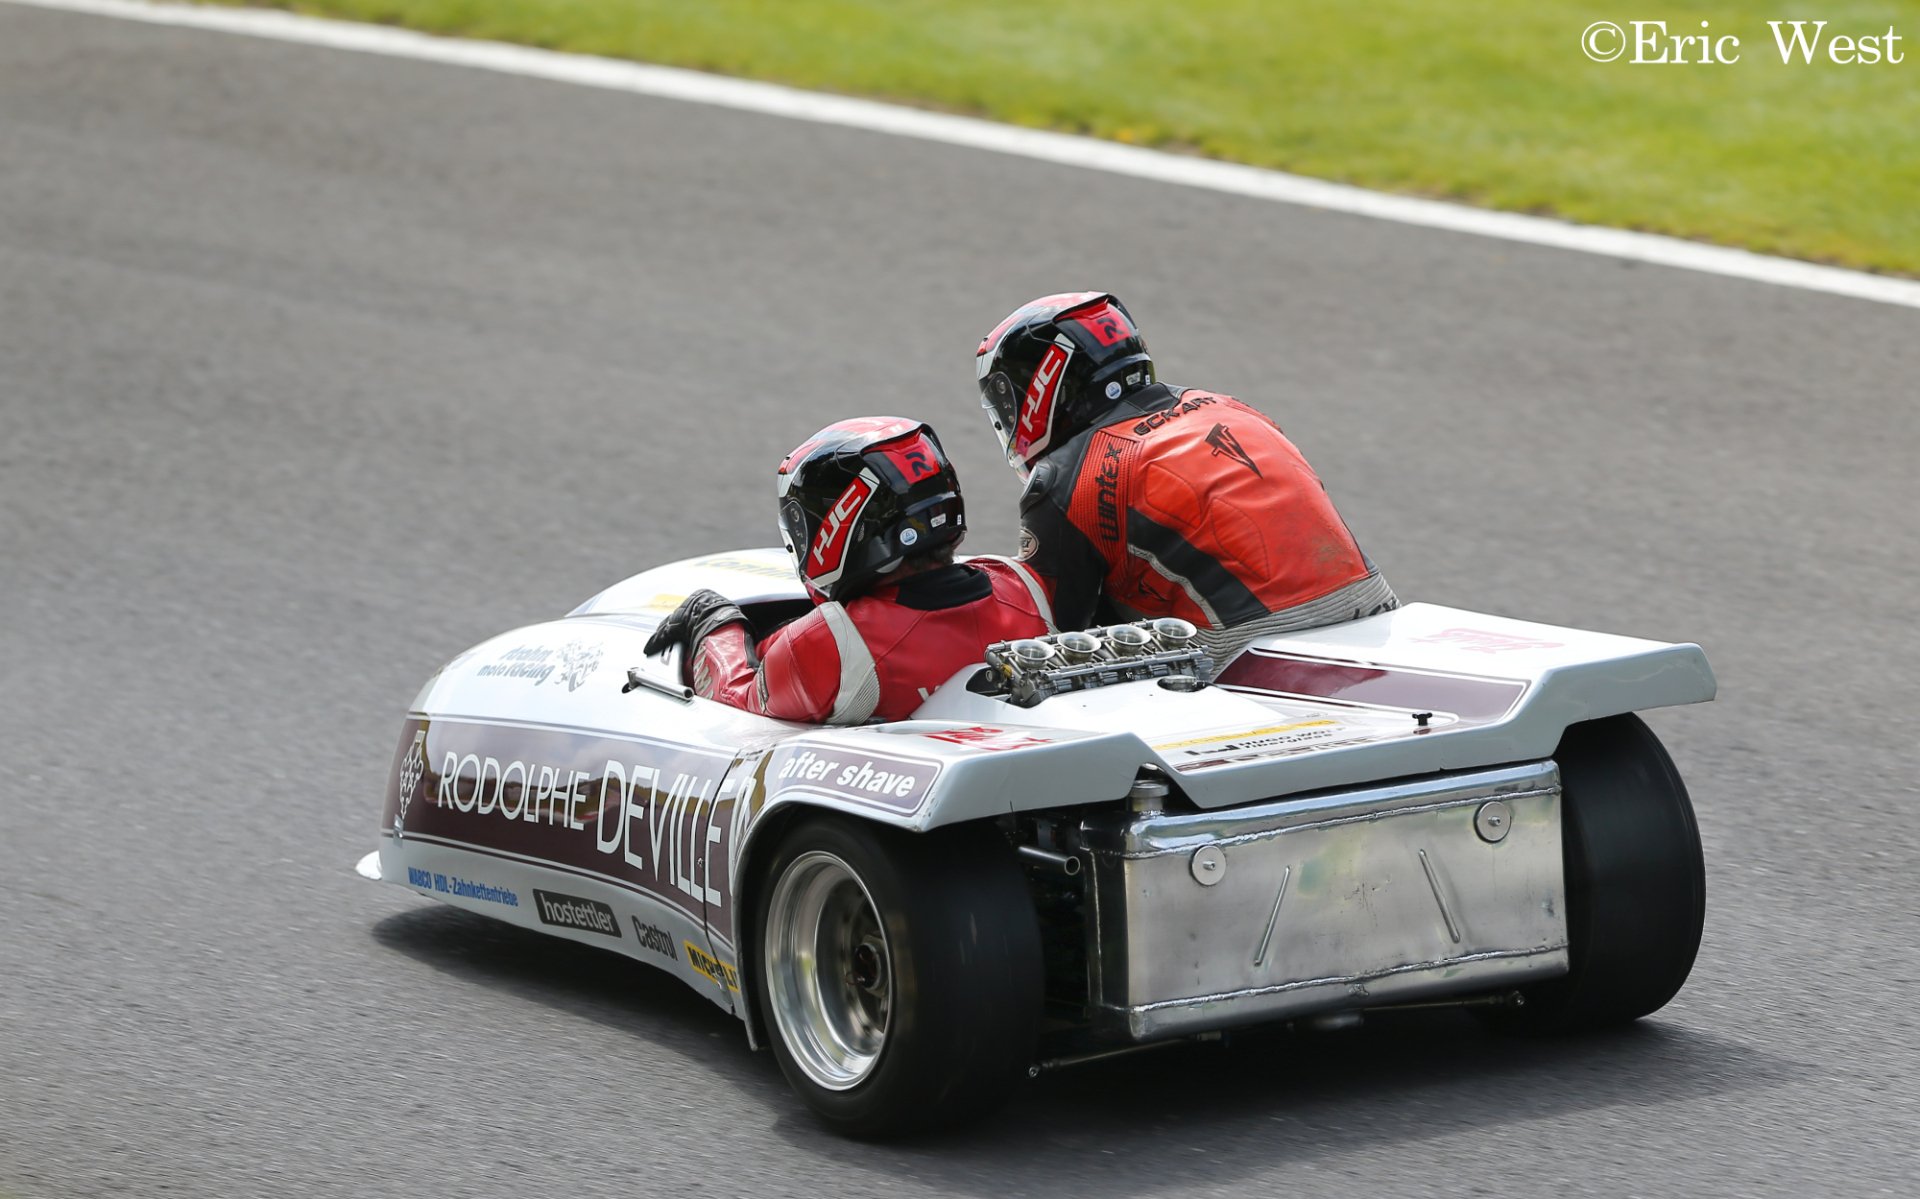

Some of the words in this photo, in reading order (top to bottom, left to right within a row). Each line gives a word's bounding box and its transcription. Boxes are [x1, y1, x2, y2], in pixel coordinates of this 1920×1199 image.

[1021, 350, 1062, 433] HJC
[813, 484, 862, 566] HJC
[438, 751, 591, 831] RODOLPHE
[778, 751, 840, 781] after
[836, 761, 916, 798] shave
[540, 892, 614, 933] hostettler
[632, 915, 678, 962] Castrol
